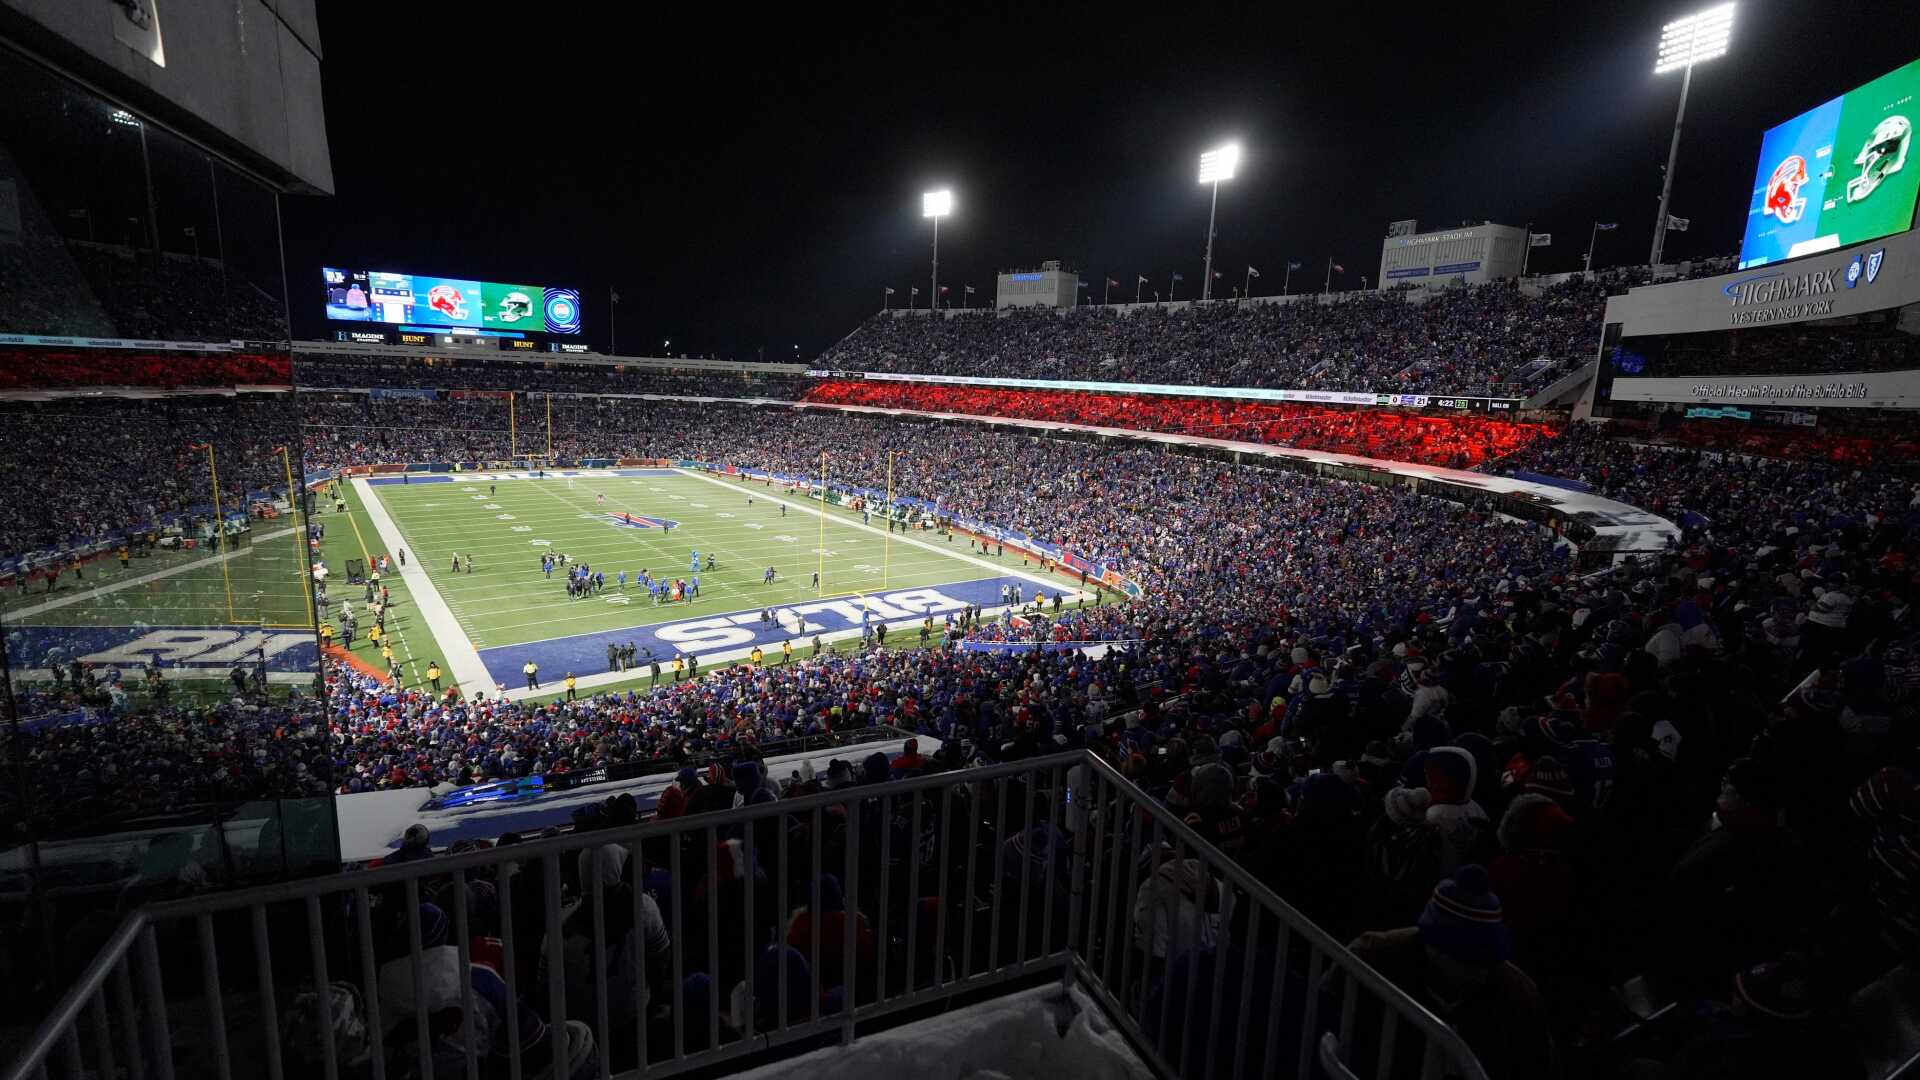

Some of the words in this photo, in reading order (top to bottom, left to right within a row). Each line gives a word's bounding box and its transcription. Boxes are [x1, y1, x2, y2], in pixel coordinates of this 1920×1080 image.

[1731, 268, 1838, 306] HIGHMARK
[1730, 308, 1778, 325] WESTERN
[1779, 305, 1801, 319] NEW
[1803, 300, 1834, 316] YORK
[402, 335, 425, 343] HUNT
[1692, 384, 1726, 397] Official
[1728, 384, 1760, 398] Health
[1761, 384, 1784, 398] Plan
[1784, 383, 1796, 398] of
[1796, 384, 1812, 398] the
[1815, 382, 1845, 398] Buffalo
[1847, 382, 1866, 398] Bills
[1438, 399, 1454, 407] 4:22
